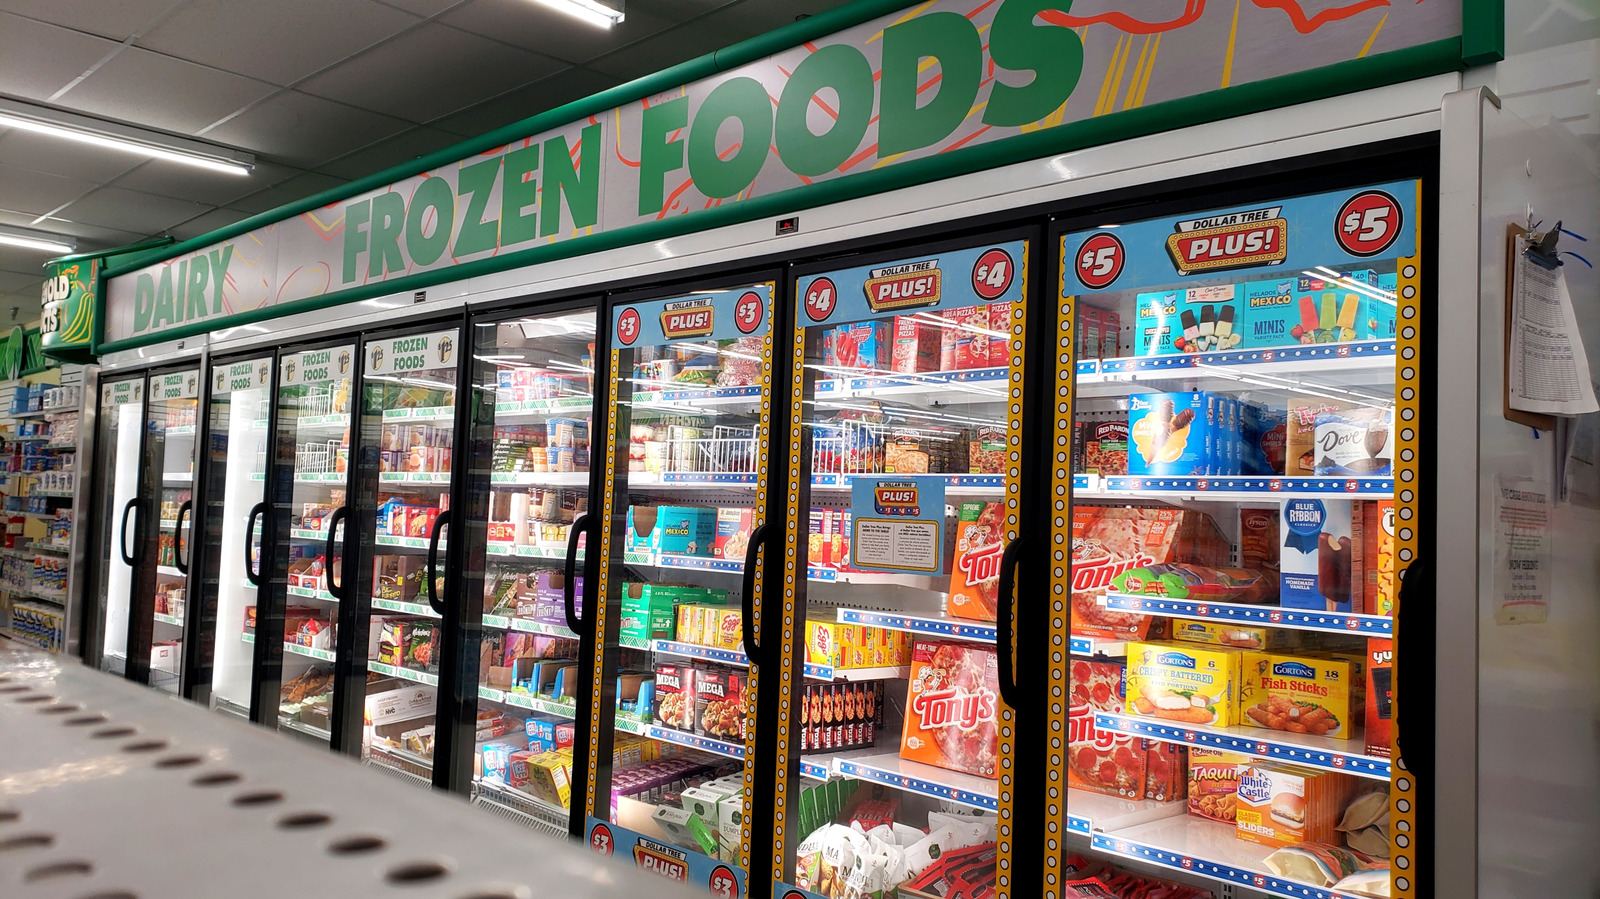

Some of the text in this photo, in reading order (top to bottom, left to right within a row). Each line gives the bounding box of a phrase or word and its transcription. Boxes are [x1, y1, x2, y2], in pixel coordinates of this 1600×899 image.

[341, 0, 1085, 285] FROZEN FOODS
[1193, 210, 1269, 230] DOLLAR TREE
[1343, 205, 1391, 241] $5
[1189, 229, 1274, 260] PLUS!
[881, 262, 930, 276] DOLLAR TREE
[1082, 248, 1116, 275] $5
[976, 260, 1008, 288] $4
[133, 244, 235, 333] DAIRY
[878, 276, 932, 300] PLUS!
[672, 300, 706, 310] DOLLAR TREE
[808, 288, 832, 312] $4
[1251, 295, 1292, 307] MEXICO
[739, 302, 757, 324] $3
[991, 304, 1012, 312] PIZZAS
[1140, 306, 1176, 318] MECO
[620, 316, 636, 336] $3
[669, 312, 708, 330] PLUS!
[1254, 320, 1285, 335] MINIS
[392, 337, 428, 354] FROZEN
[1144, 335, 1170, 346] MIS
[302, 352, 330, 366] FROZEN
[394, 354, 425, 371] FOODS
[230, 363, 253, 377] FROZEN
[304, 367, 328, 381] FOODS
[164, 374, 184, 386] FROZEN
[230, 377, 250, 390] FOODS
[164, 388, 181, 398] FOODS
[1098, 426, 1109, 435] RED
[1317, 431, 1362, 451] Dove
[882, 492, 914, 501] PLUS!
[1290, 510, 1320, 523] RIBBON
[962, 545, 1002, 583] Ton
[722, 615, 740, 631] Eggo
[818, 625, 829, 656] Eggo
[1158, 656, 1194, 667] GORTON'S
[1139, 666, 1214, 684] CRISPY BATTERED
[1274, 666, 1313, 678] GORTON'S
[656, 674, 680, 689] MEGA
[1166, 682, 1198, 690] PORTIONS
[1261, 677, 1287, 689] Fish
[1290, 681, 1328, 697] Sticks
[698, 682, 724, 697] MEGA
[914, 687, 995, 729] Tony's
[1257, 744, 1266, 752] $5
[1333, 758, 1343, 766] $5
[1191, 766, 1238, 781] TAQUIT
[1241, 775, 1268, 788] White
[1239, 786, 1270, 798] Castle
[724, 826, 741, 836] DUMPL
[1238, 822, 1274, 836] SLIDERS
[594, 834, 609, 854] $3
[646, 842, 681, 859] DOLLAR TREE
[644, 856, 683, 880] PLUS!
[714, 876, 732, 899] $3
